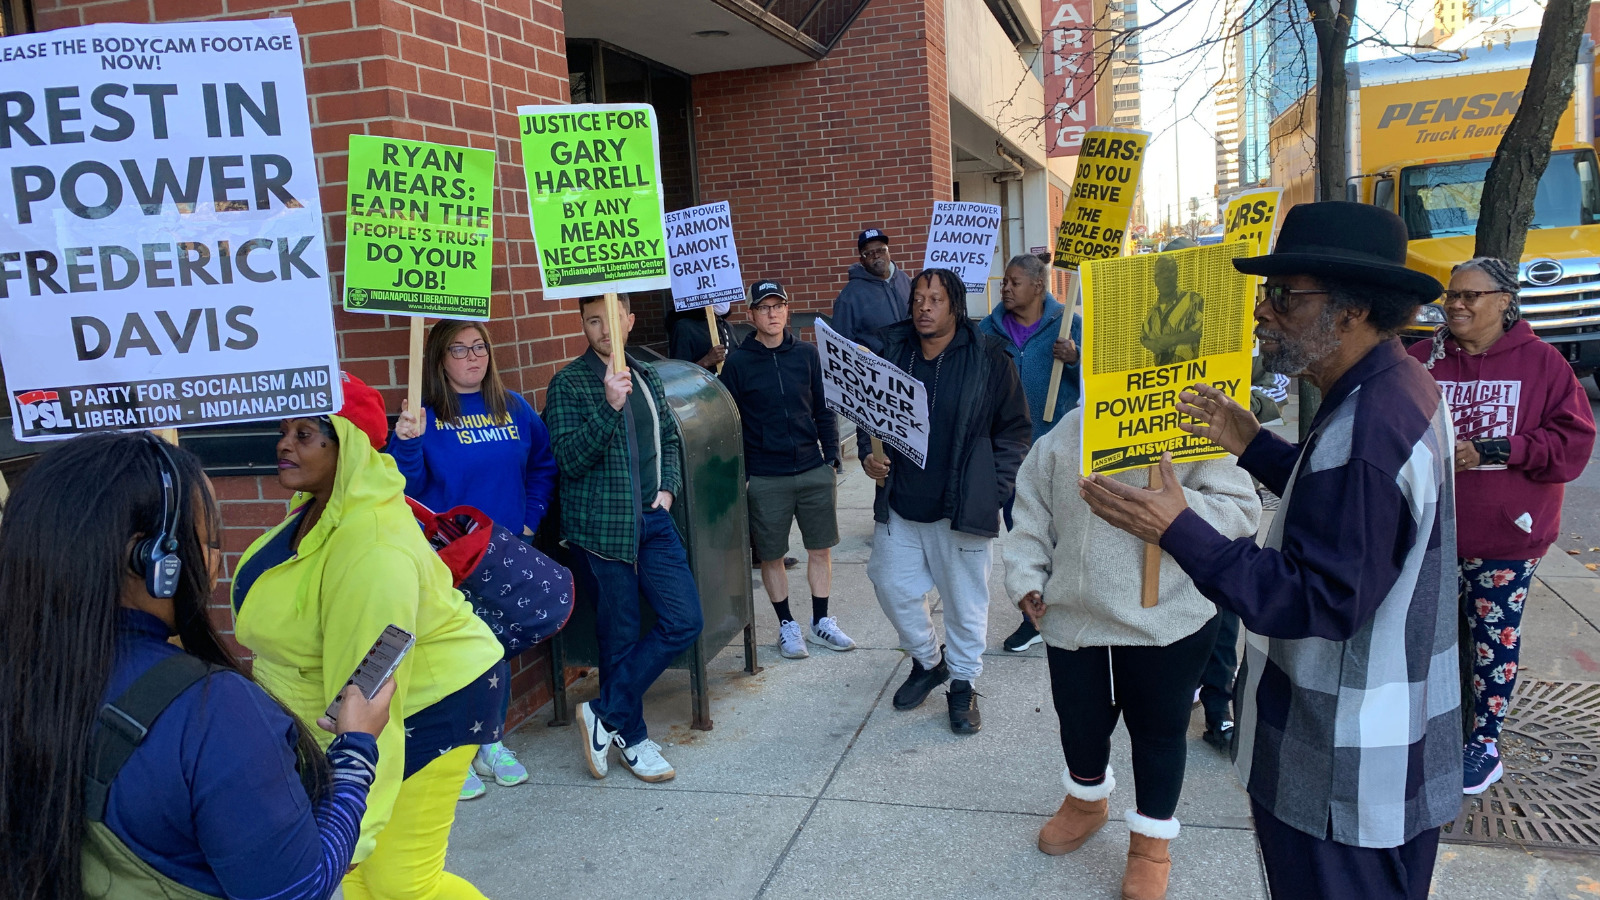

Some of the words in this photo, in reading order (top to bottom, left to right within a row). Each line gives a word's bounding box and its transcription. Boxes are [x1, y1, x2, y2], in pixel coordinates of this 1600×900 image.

[52, 38, 87, 56] THE
[92, 37, 196, 54] BODYCAM
[201, 35, 293, 53] FOOTAGE
[101, 54, 162, 71] NOW!
[1050, 0, 1087, 148] ARKING
[0, 83, 178, 149] REST
[202, 81, 282, 138] IN
[1377, 91, 1523, 129] PENSK
[523, 113, 601, 135] JUSTICE
[605, 111, 649, 131] FOR
[1416, 129, 1458, 144] Truck
[1463, 124, 1508, 139] Renta
[382, 142, 463, 174] RYAN
[551, 138, 627, 165] GARY
[366, 168, 475, 201] MEARS:
[535, 164, 650, 194] HARRELL
[1095, 164, 1131, 183] YOU
[11, 153, 305, 224] POWER
[1074, 183, 1121, 202] SERVE
[351, 194, 429, 222] EARN
[439, 203, 489, 229] THE
[562, 200, 588, 219] BY
[593, 197, 632, 217] ANY
[682, 210, 691, 219] IN
[692, 204, 726, 217] POWER
[938, 203, 956, 211] REST
[958, 204, 967, 212] IN
[968, 205, 998, 215] POWER
[1077, 206, 1102, 223] THE
[560, 218, 640, 244] MEANS
[933, 214, 999, 230] D'ARMON
[1060, 221, 1101, 239] PEOPLE
[1102, 228, 1124, 244] OR
[353, 222, 431, 242] PEOPLE'S
[436, 229, 489, 247] TRUST
[668, 235, 728, 258] LAMONT
[933, 231, 992, 246] LAMONT
[366, 243, 403, 263] DO
[409, 246, 477, 270] YOUR
[543, 239, 661, 267] NECESSARY
[930, 250, 988, 267] GRAVES,
[1057, 237, 1072, 251] THE
[1074, 240, 1120, 259] COPS?
[0, 235, 321, 299] FREDERICK
[561, 264, 606, 277] Indianapolis
[606, 262, 639, 272] Liberation
[640, 260, 664, 269] Center
[604, 268, 665, 279] IndyLiberationCenter.org
[673, 255, 735, 277] GRAVES,
[392, 268, 446, 291] JOB!
[696, 274, 717, 290] JR!
[370, 290, 419, 303] INDIANAPOLIS
[420, 293, 459, 306] LIBERATION
[460, 296, 487, 307] CENTER
[70, 305, 259, 362] DAVIS
[826, 340, 880, 383] REST
[888, 375, 915, 400] IN
[1127, 365, 1183, 391] REST
[1187, 360, 1207, 381] IN
[71, 384, 134, 406] PARTY
[137, 380, 176, 403] FOR
[181, 373, 286, 399] SOCIALISM
[291, 370, 329, 389] AND
[828, 357, 916, 418] POWER
[1095, 389, 1176, 419] POWER
[1180, 378, 1241, 398] RY
[74, 406, 183, 428] LIBERATION
[200, 391, 328, 419] INDIANAPOLIS
[823, 368, 925, 434] FREDERICK
[22, 403, 72, 430] PSL
[841, 391, 908, 439] DAVIS
[1118, 411, 1204, 439] HARREL
[456, 425, 520, 444] ISLIMITE
[1095, 453, 1122, 467] ANSWER
[1126, 441, 1183, 458] ANSWER
